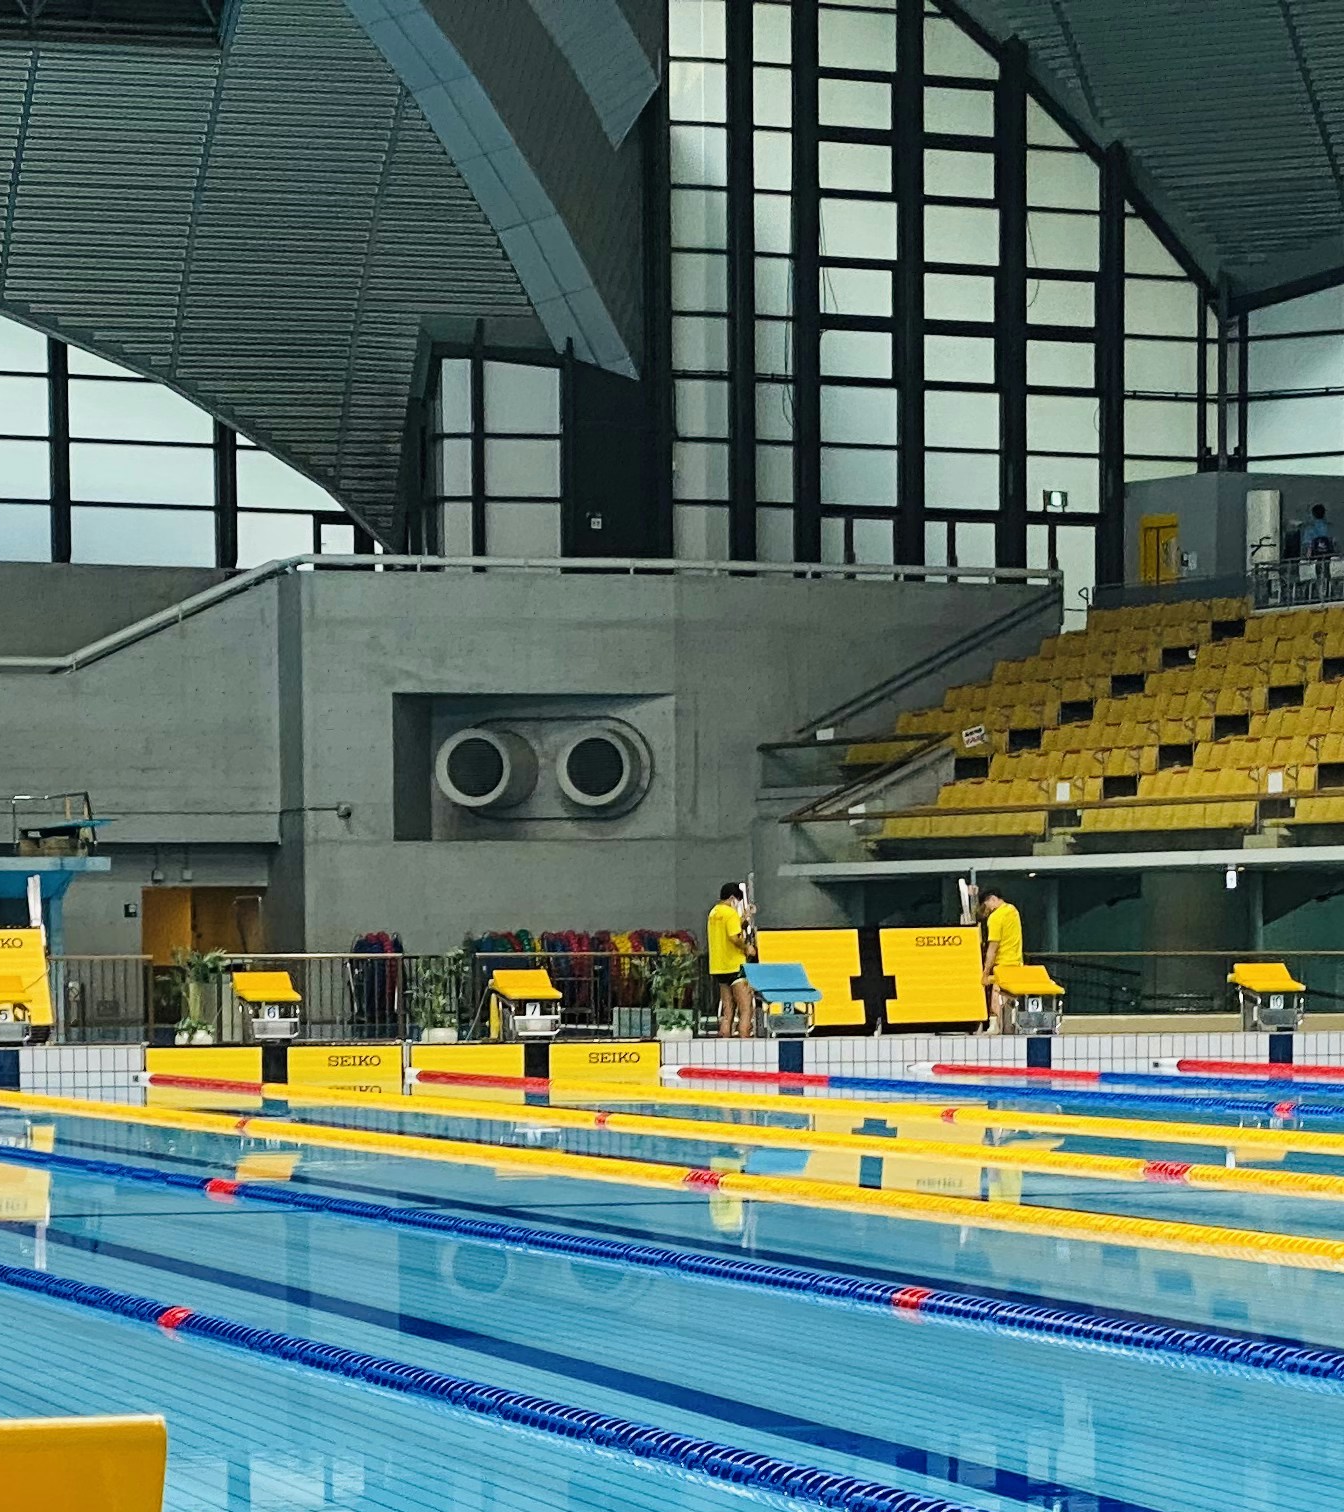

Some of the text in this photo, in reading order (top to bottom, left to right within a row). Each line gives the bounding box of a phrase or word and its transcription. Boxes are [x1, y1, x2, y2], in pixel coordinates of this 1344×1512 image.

[915, 935, 963, 947] SEIKO
[528, 1003, 537, 1015] 7
[784, 1002, 792, 1014] 8
[1031, 999, 1039, 1010] 9
[0, 1009, 8, 1021] 5
[267, 1006, 276, 1018] 6
[328, 1055, 382, 1068] SEIKO
[588, 1052, 641, 1064] SEIKO
